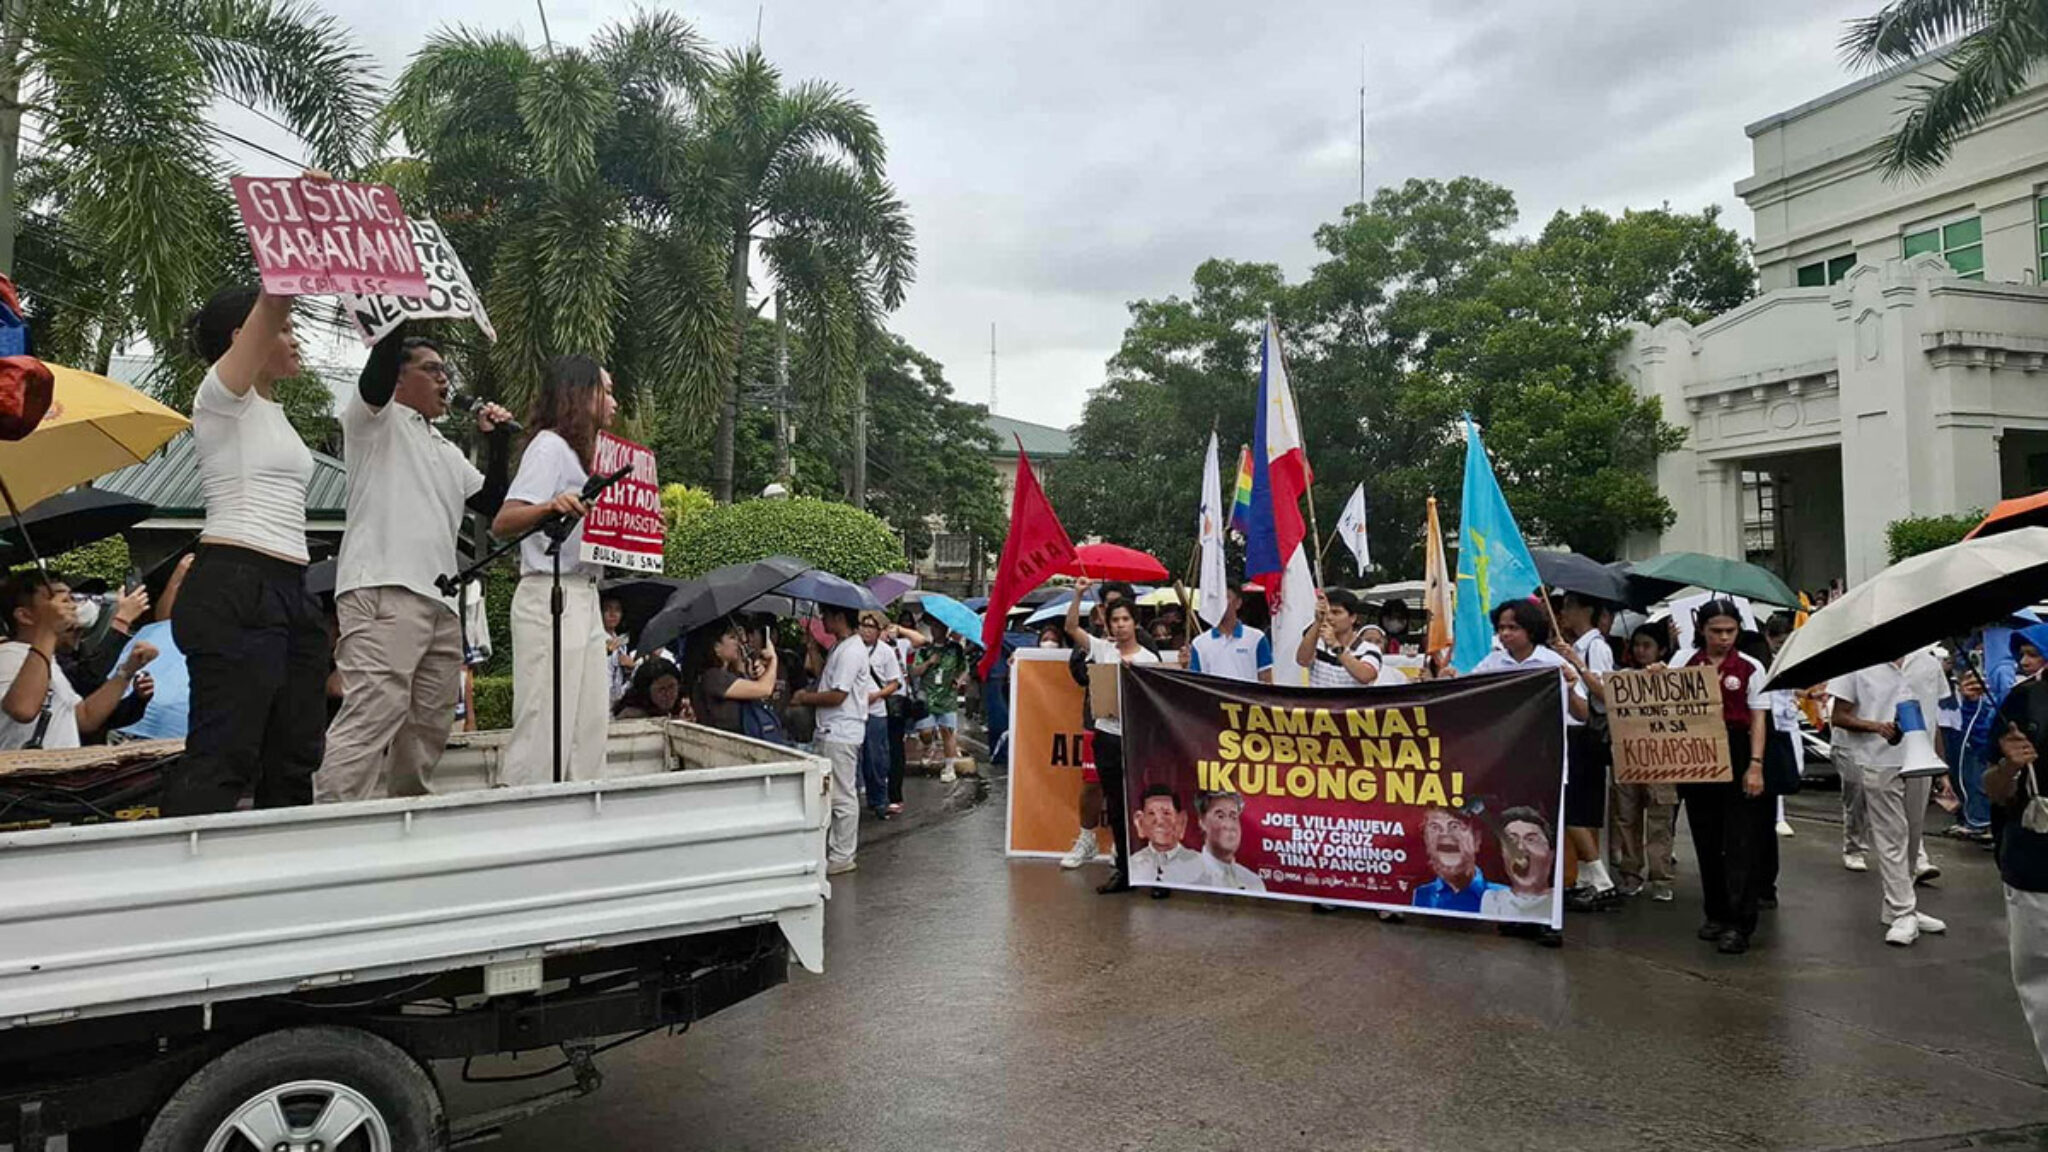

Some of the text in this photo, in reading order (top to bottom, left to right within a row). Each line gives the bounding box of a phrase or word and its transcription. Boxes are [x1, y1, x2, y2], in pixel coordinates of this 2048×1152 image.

[250, 224, 415, 274] KABATAAN
[1609, 670, 1709, 704] BUMUSINA
[1220, 703, 1430, 738] TAMA NA!
[1650, 720, 1688, 733] KA SA
[1218, 730, 1441, 771] SOBRA NA!
[1197, 760, 1464, 807] IKULONG NA!
[1261, 812, 1405, 836] JOEL VILLANUEVA
[1292, 829, 1373, 847] BOY CRUZ
[1262, 838, 1407, 862] DANNY DOMINGO
[1278, 852, 1392, 875] TINA PANCHO
